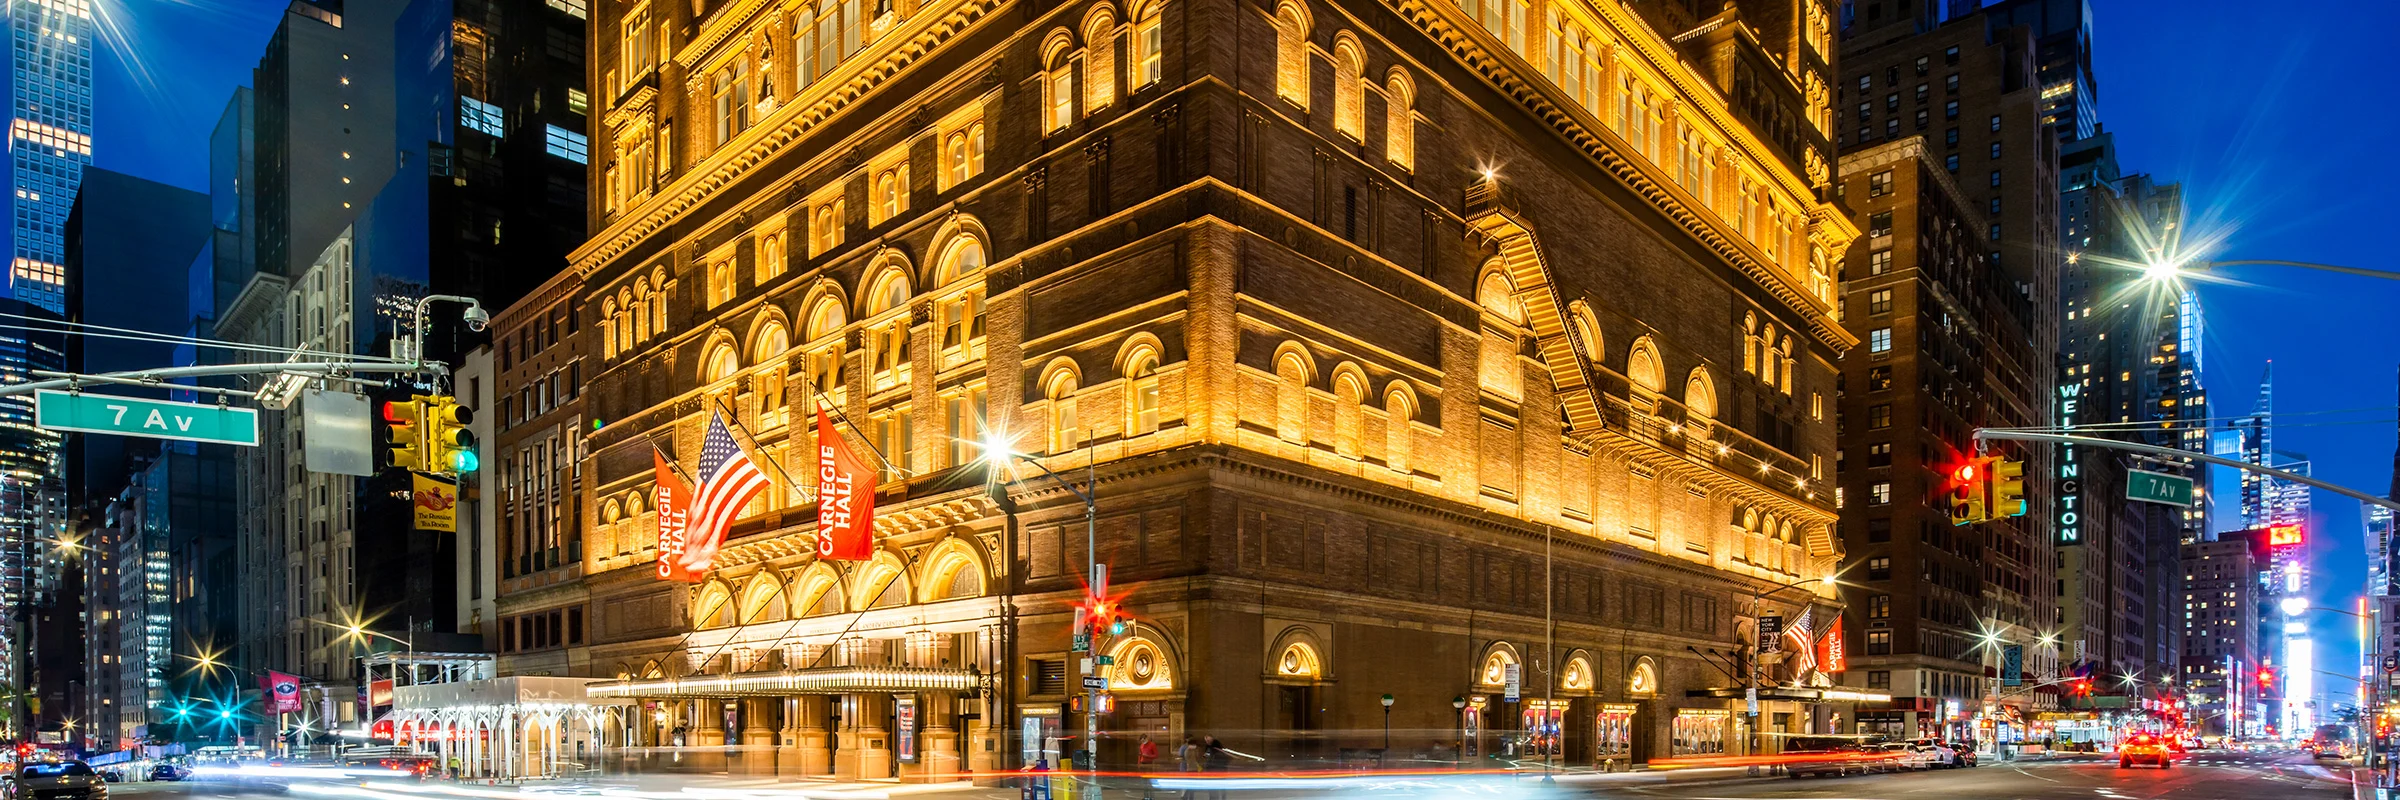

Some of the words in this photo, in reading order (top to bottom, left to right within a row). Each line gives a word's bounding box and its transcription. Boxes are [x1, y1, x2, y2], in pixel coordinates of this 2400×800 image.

[106, 404, 128, 426] 7
[143, 408, 194, 432] Av
[2060, 383, 2081, 541] WELINGTON
[820, 445, 836, 556] CARNEGIE
[834, 472, 852, 529] HALL
[2150, 478, 2157, 495] 7
[2160, 481, 2176, 498] Av
[658, 486, 671, 577] CARNEGIE
[671, 508, 687, 555] HALL
[1829, 632, 1837, 670] CARNEGIE
[1834, 639, 1842, 659] HALL
